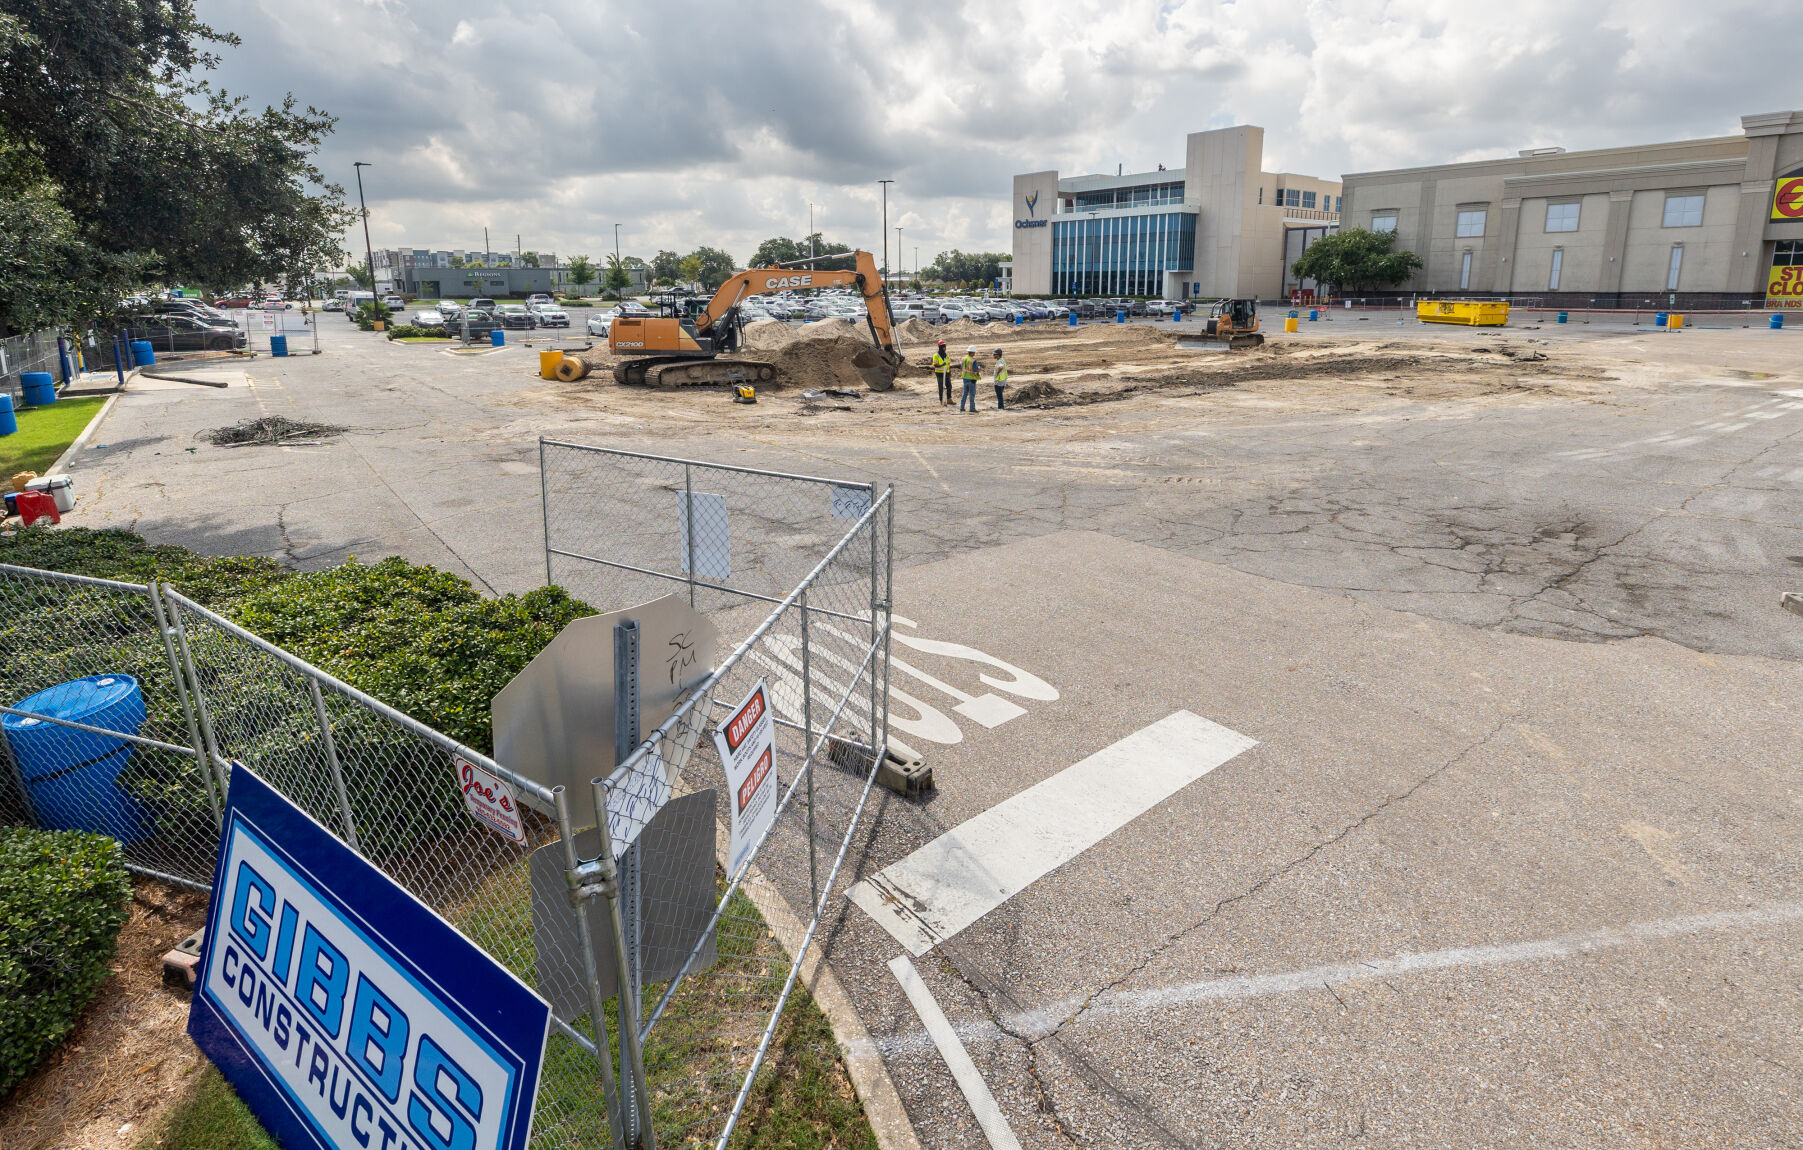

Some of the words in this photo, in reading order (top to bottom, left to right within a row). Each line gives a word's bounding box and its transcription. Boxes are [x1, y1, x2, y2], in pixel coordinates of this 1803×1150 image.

[1015, 219, 1047, 229] Ochsner
[766, 275, 811, 289] CASE
[732, 698, 761, 743] DANGER
[462, 765, 514, 813] Joe's
[741, 755, 769, 805] PELIGRO
[230, 859, 484, 1150] GIBBS
[222, 944, 408, 1150] CONSTRUCT
